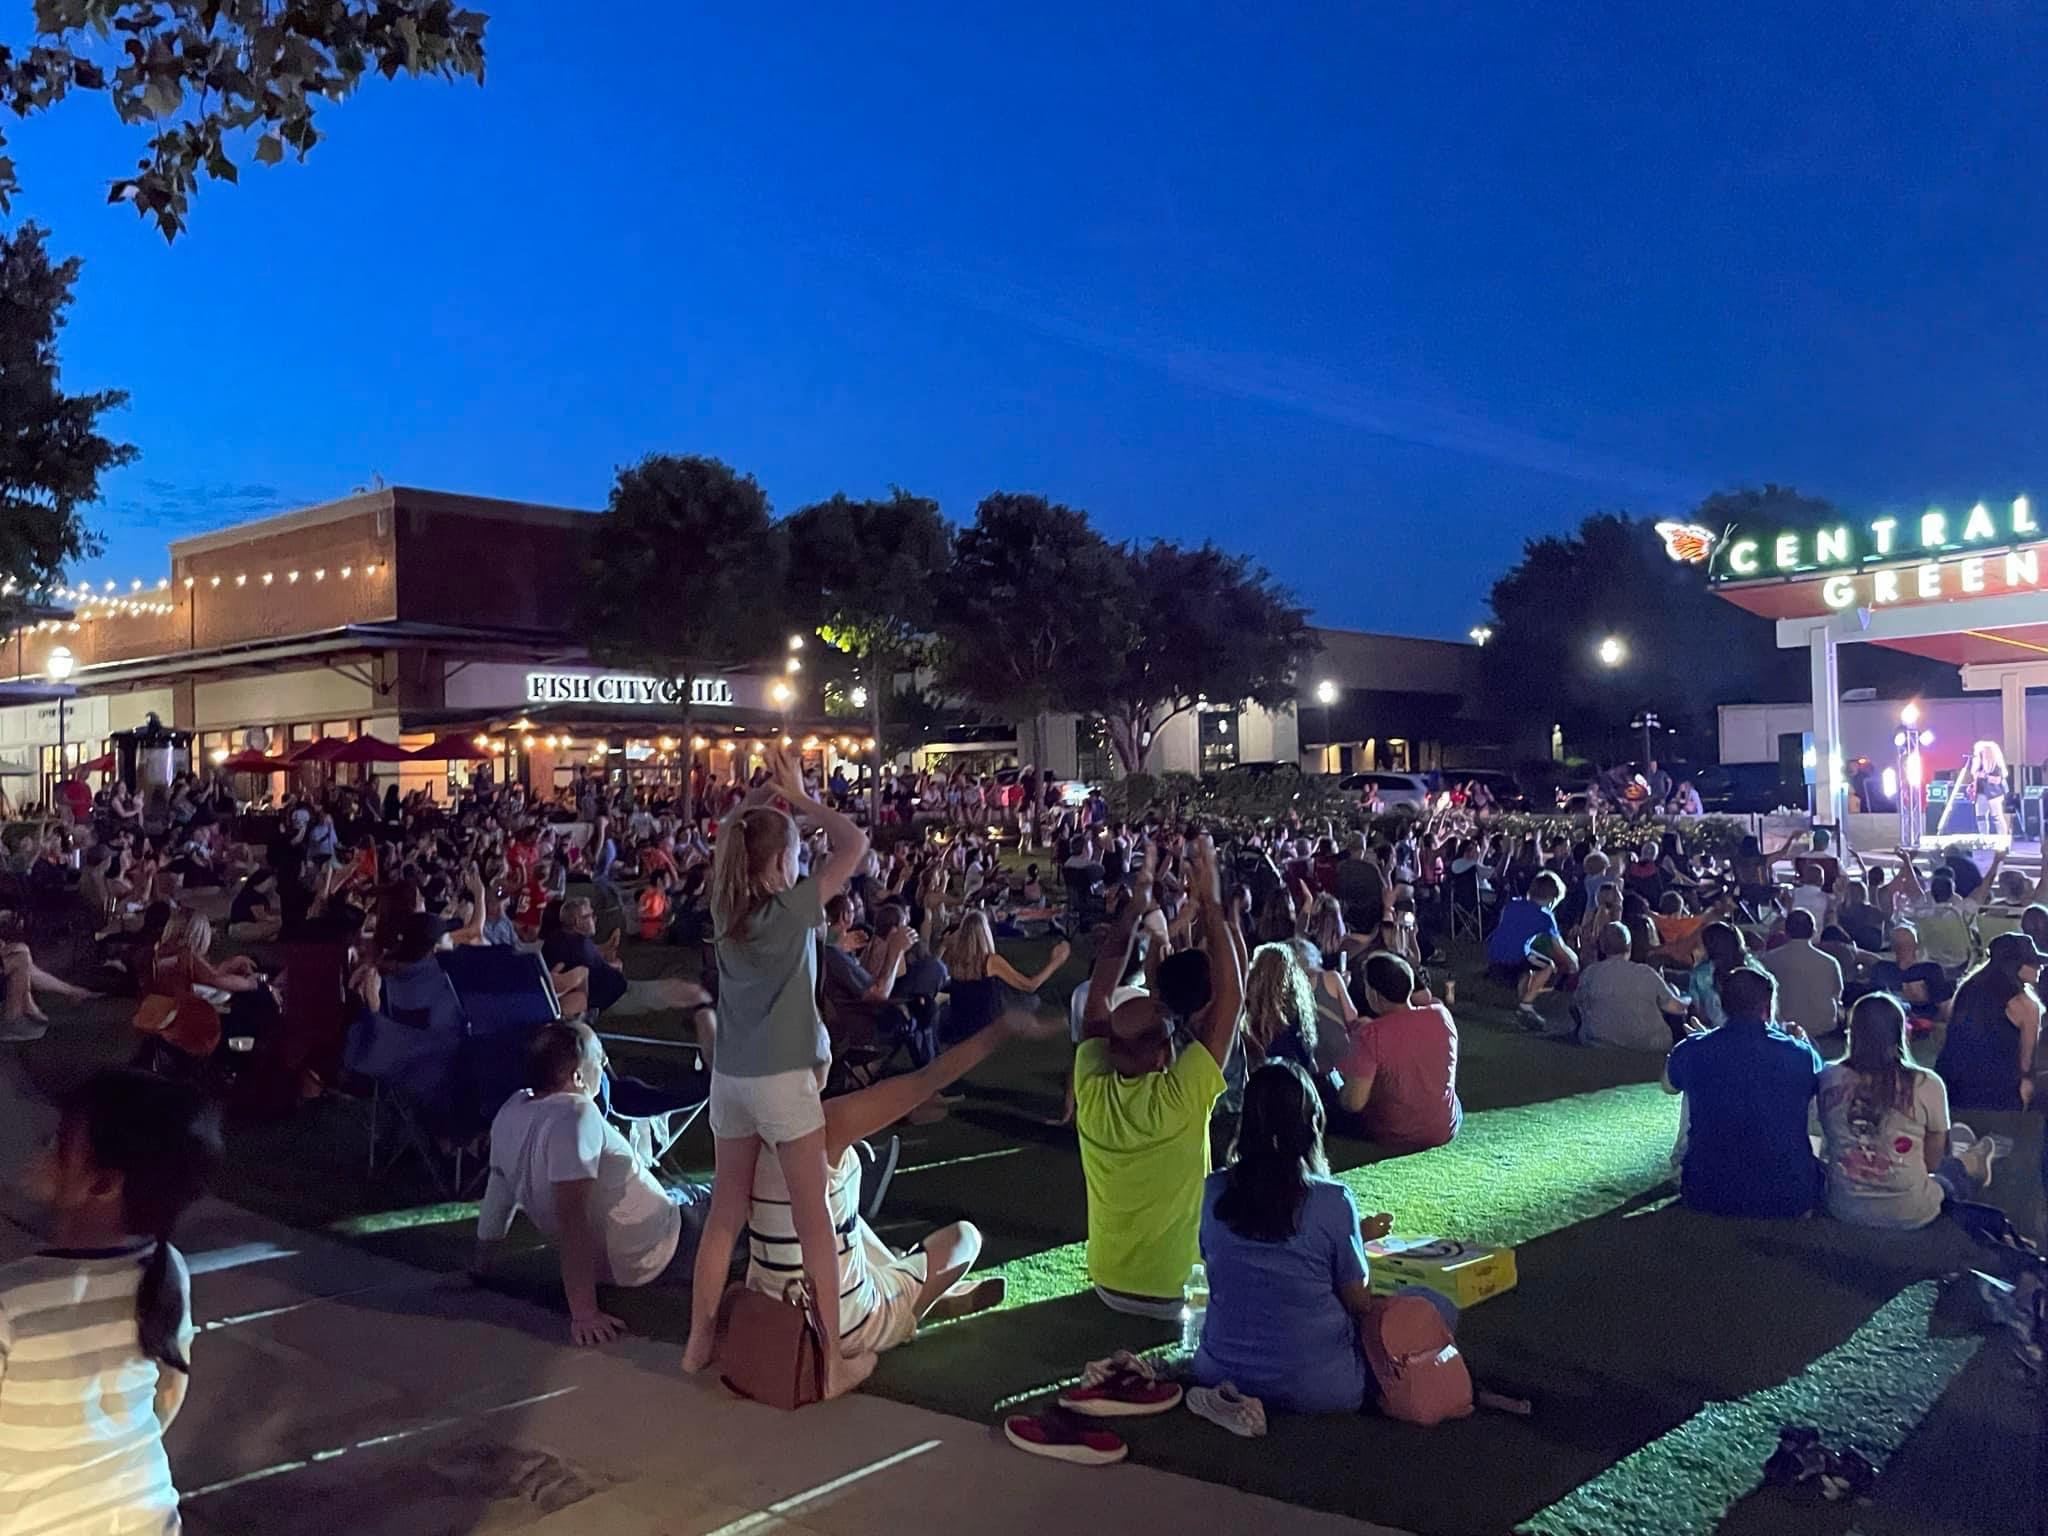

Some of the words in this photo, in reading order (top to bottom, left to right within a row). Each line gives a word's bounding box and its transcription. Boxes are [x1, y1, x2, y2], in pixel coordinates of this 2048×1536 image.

[1729, 497, 2037, 572] CENTRAL
[1822, 552, 2039, 608] GREEN
[527, 674, 590, 701] FISH
[594, 675, 656, 703] CITY
[657, 678, 733, 705] GILL
